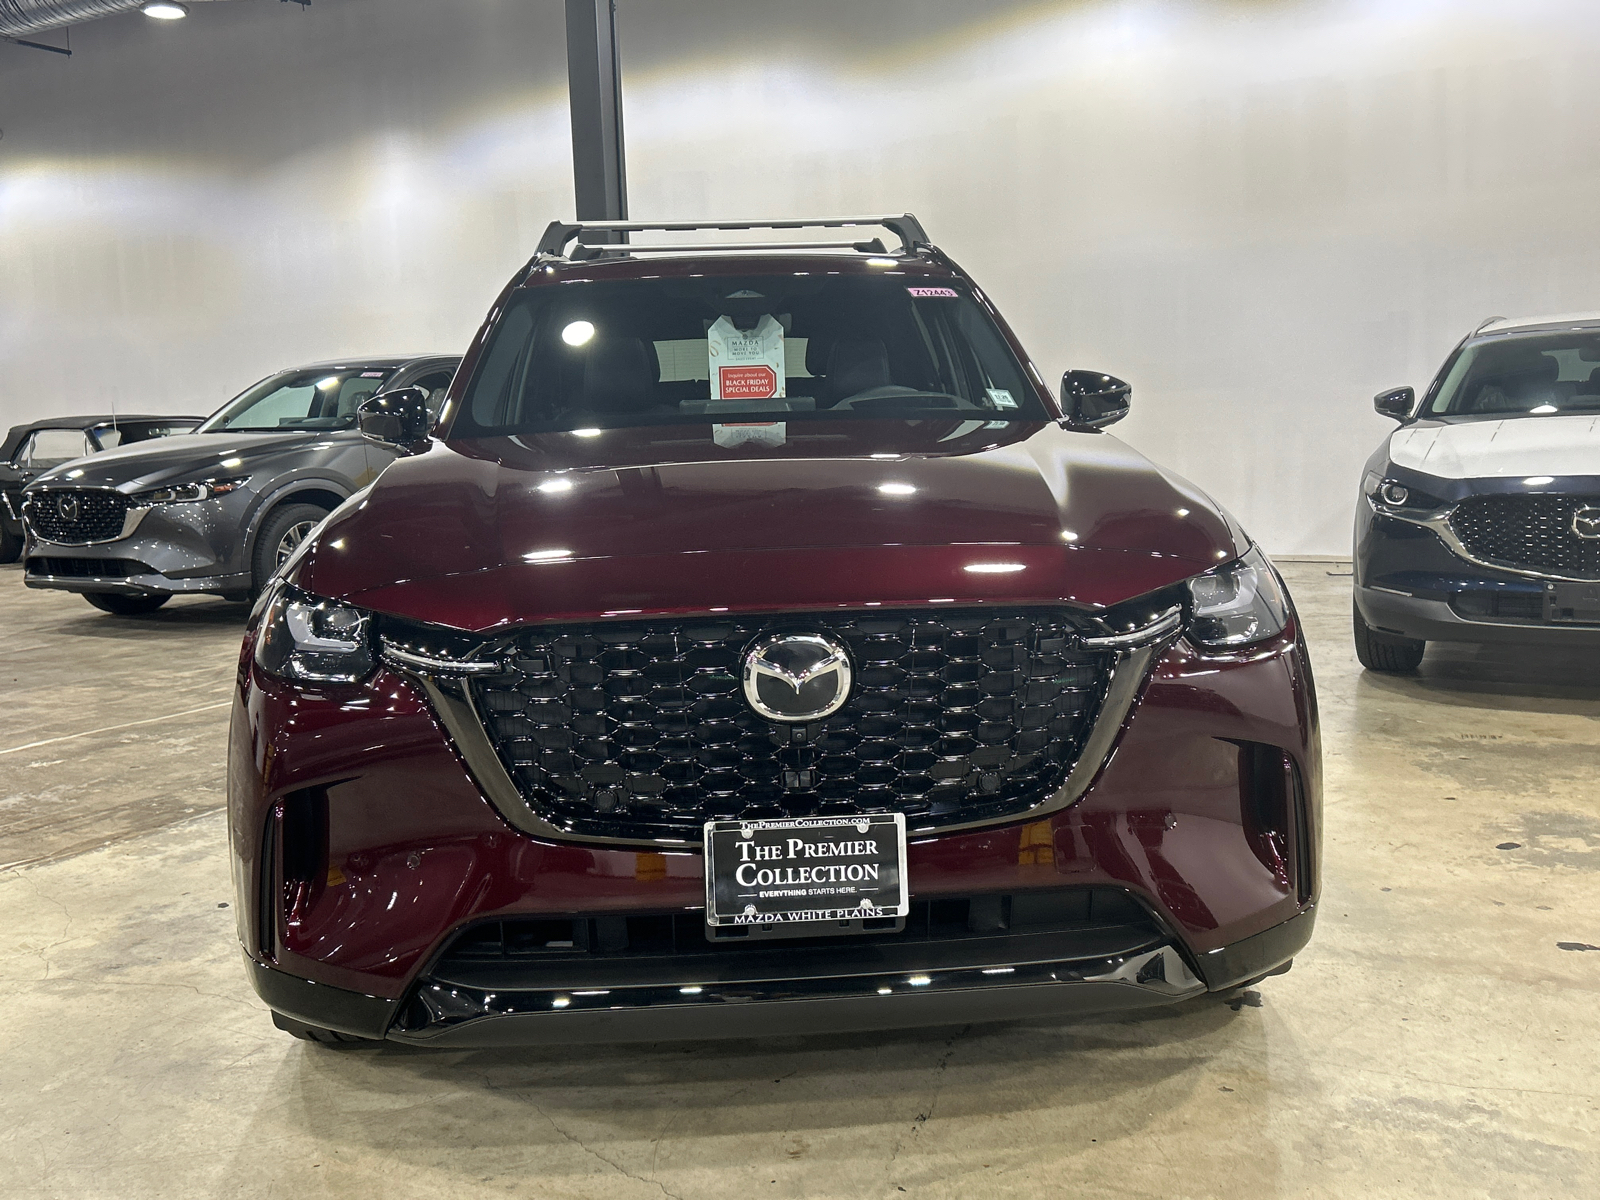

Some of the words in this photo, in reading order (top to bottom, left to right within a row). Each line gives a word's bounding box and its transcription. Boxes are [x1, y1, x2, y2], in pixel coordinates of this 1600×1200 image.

[746, 378, 769, 386] FRIDAY
[735, 840, 783, 862] THE
[786, 838, 879, 859] PREMIER
[735, 863, 880, 887] COLLECTION
[759, 889, 807, 898] EVERYTHING
[808, 887, 835, 896] STARTS
[836, 886, 858, 895] HERE.
[734, 914, 783, 924] MAZDA
[787, 910, 832, 921] WHITE
[836, 907, 884, 918] PLAINS
